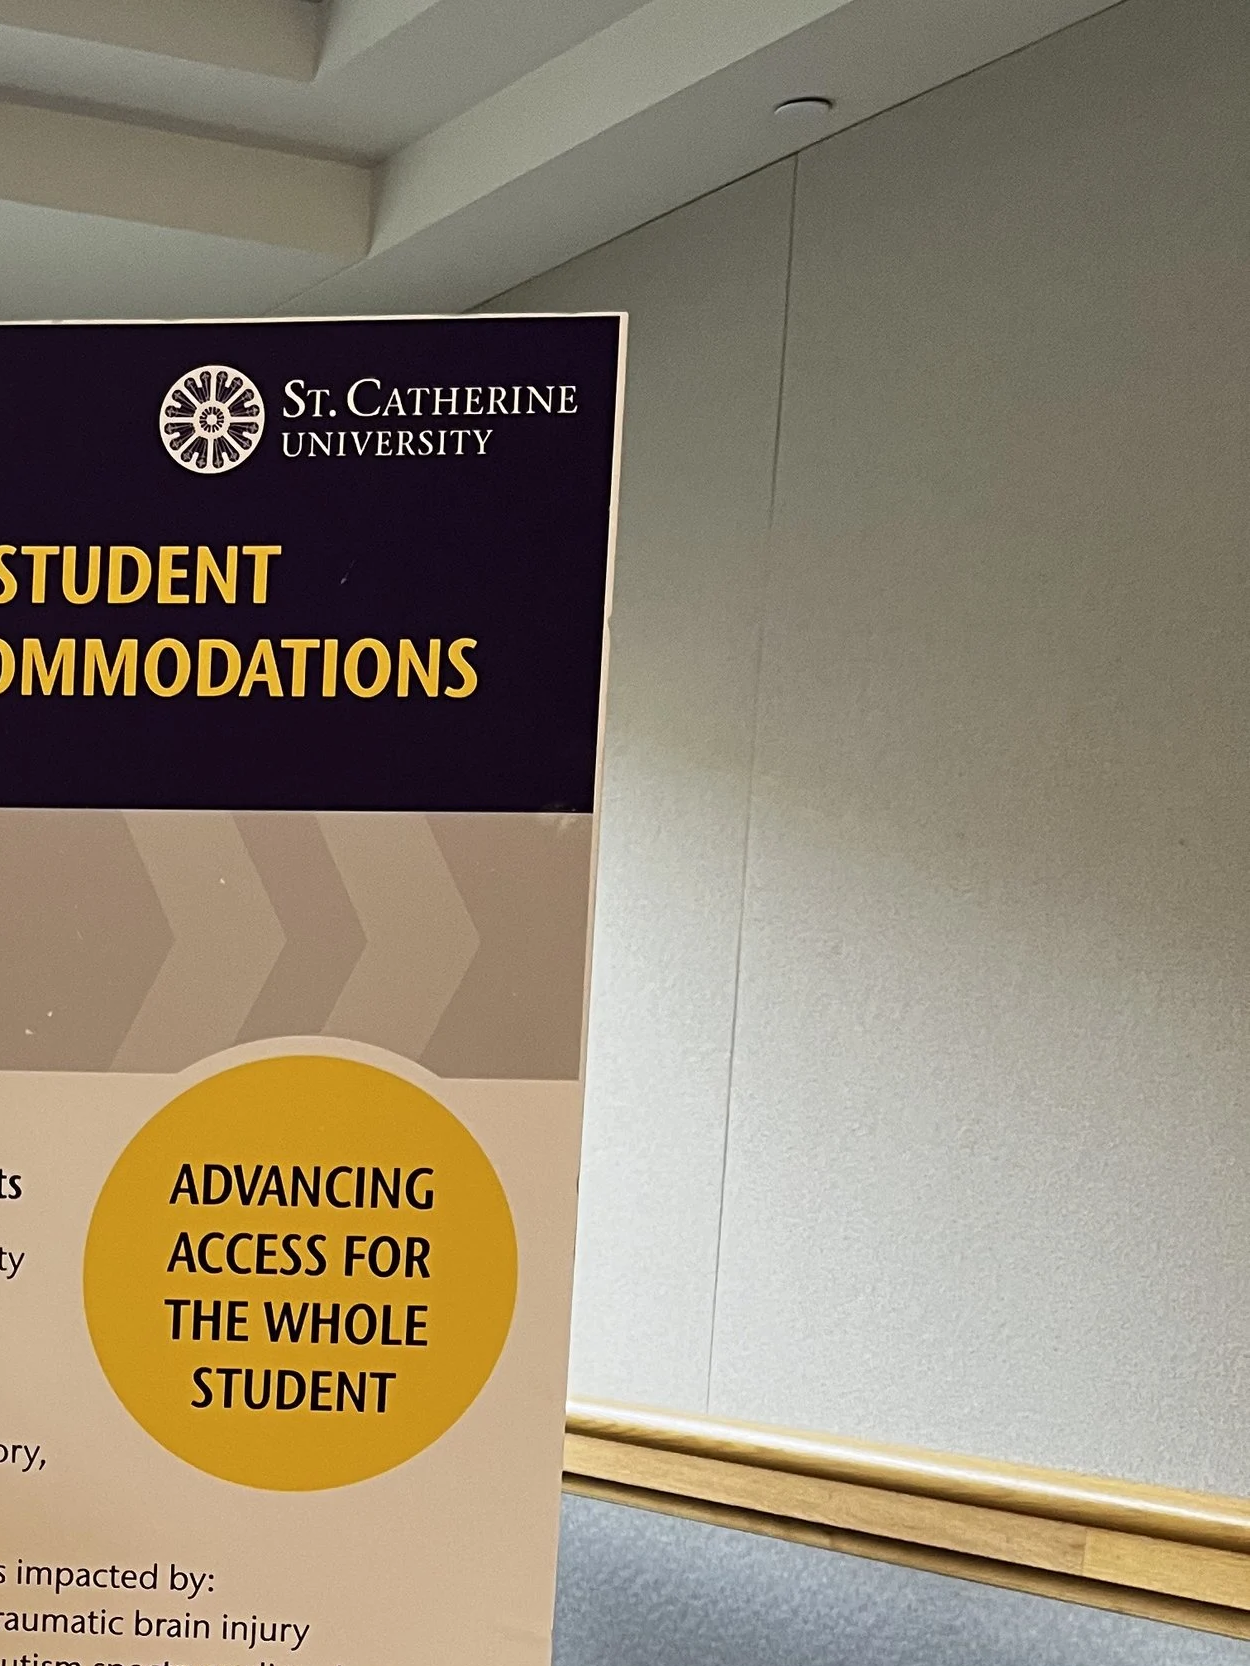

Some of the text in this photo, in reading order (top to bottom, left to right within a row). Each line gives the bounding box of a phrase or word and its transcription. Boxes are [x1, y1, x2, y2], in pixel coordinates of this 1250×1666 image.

[281, 429, 494, 458] UNIVERSITY
[168, 1163, 435, 1211] ADVANCING
[166, 1231, 431, 1279] ACCESS FOR
[163, 1298, 429, 1347] THE WHOLE
[190, 1366, 397, 1414] STUDENT
[16, 1558, 158, 1595] impacted
[169, 1563, 215, 1600] by:
[134, 1609, 210, 1640] brain
[222, 1613, 310, 1652] injury
